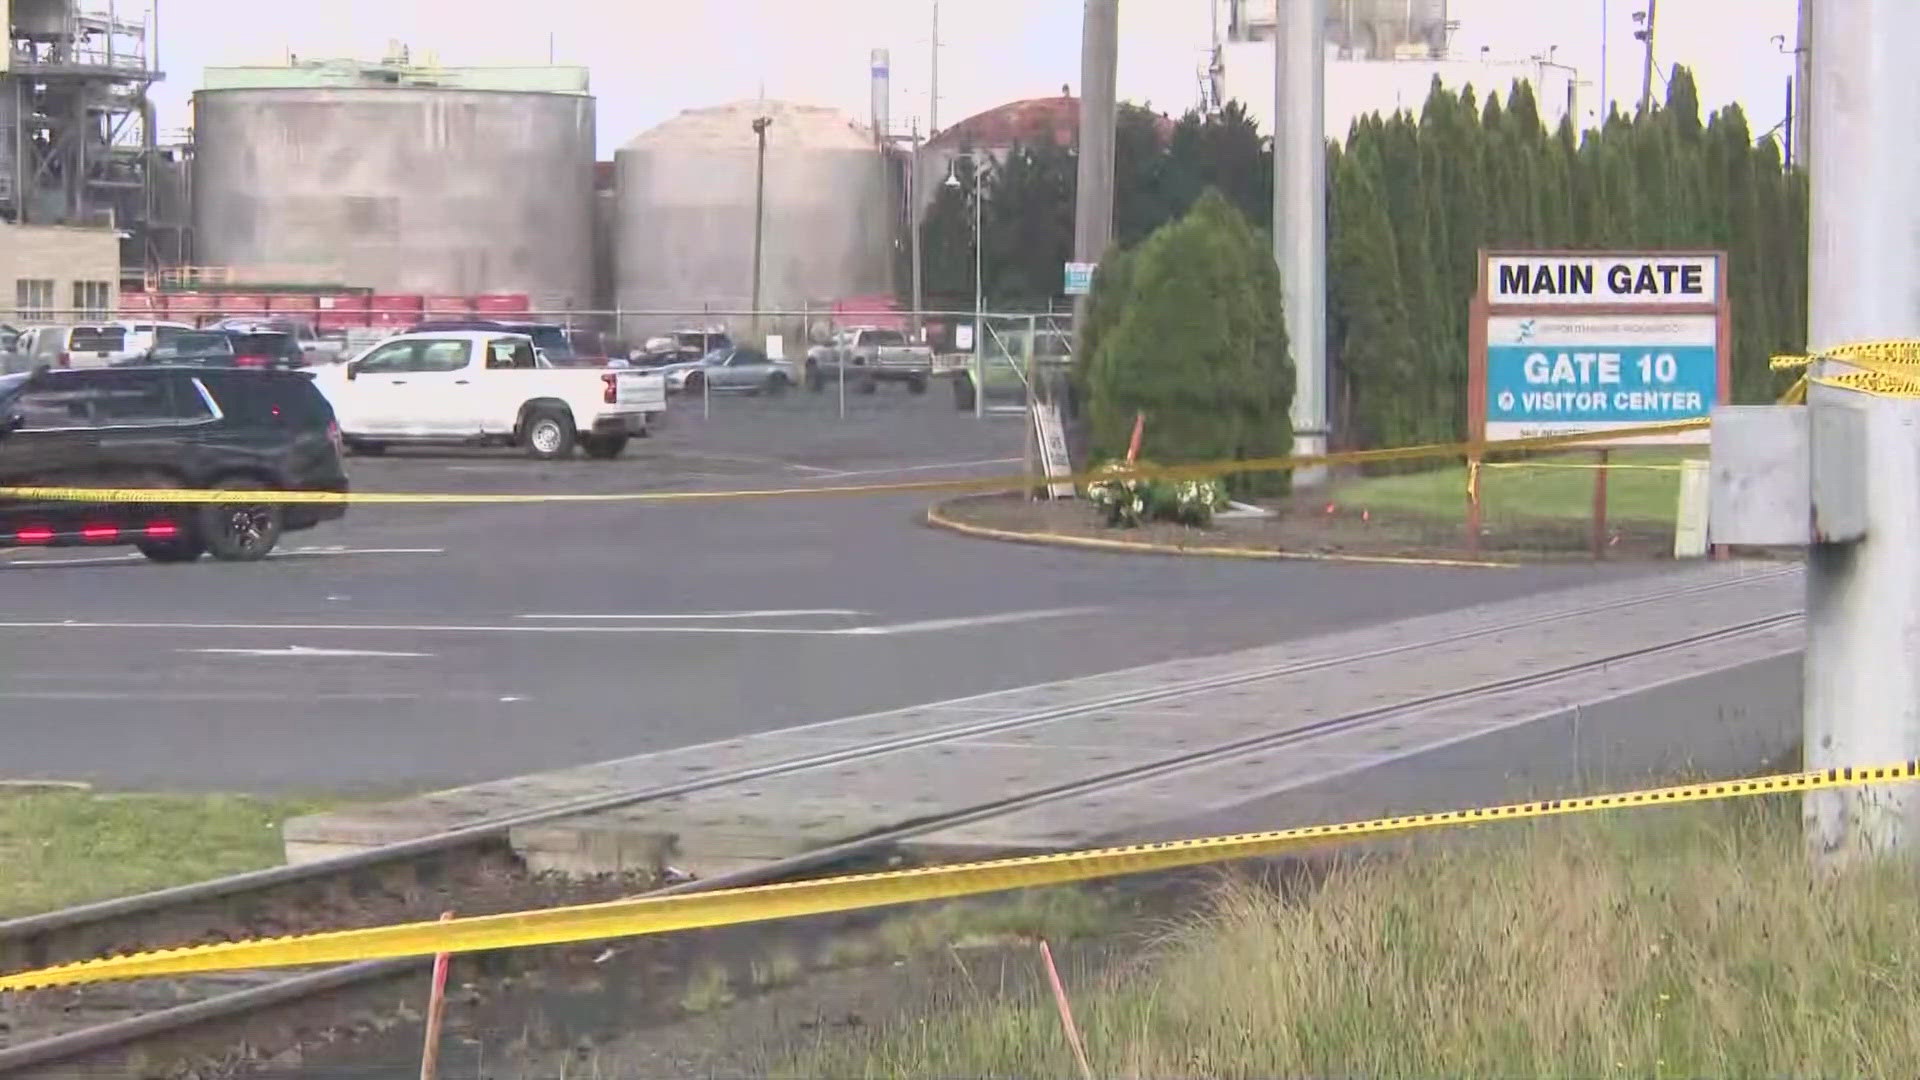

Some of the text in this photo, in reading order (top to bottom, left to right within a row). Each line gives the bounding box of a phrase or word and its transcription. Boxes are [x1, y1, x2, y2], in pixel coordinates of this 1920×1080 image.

[1500, 264, 1703, 294] MAIN GATE
[1524, 353, 1677, 384] GATE 10
[1521, 391, 1701, 411] VISITOR CENTER
